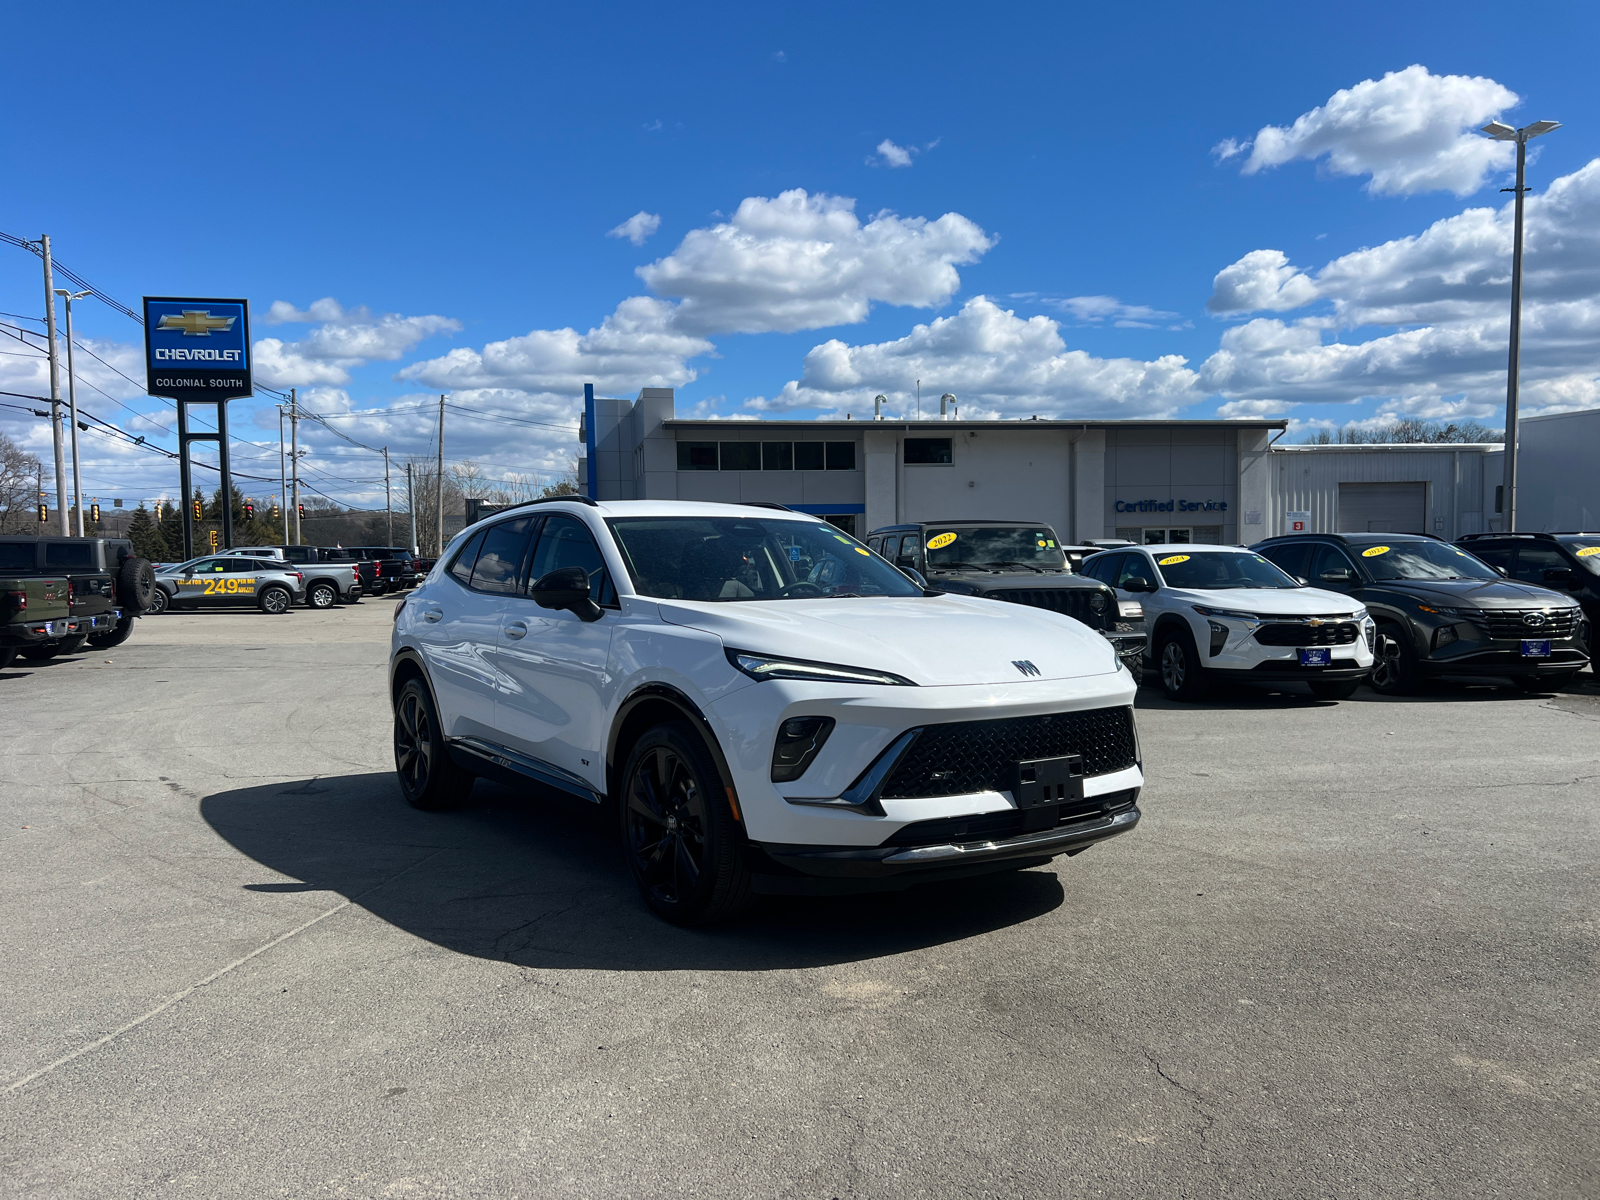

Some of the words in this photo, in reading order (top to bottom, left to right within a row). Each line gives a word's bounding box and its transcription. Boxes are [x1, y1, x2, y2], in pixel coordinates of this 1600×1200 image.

[155, 349, 241, 361] CHEVROLET
[156, 378, 206, 387] COLONIAL
[209, 379, 243, 387] SOUTH
[1115, 499, 1174, 512] Certified
[1178, 499, 1227, 512] Service
[933, 533, 952, 548] 2022
